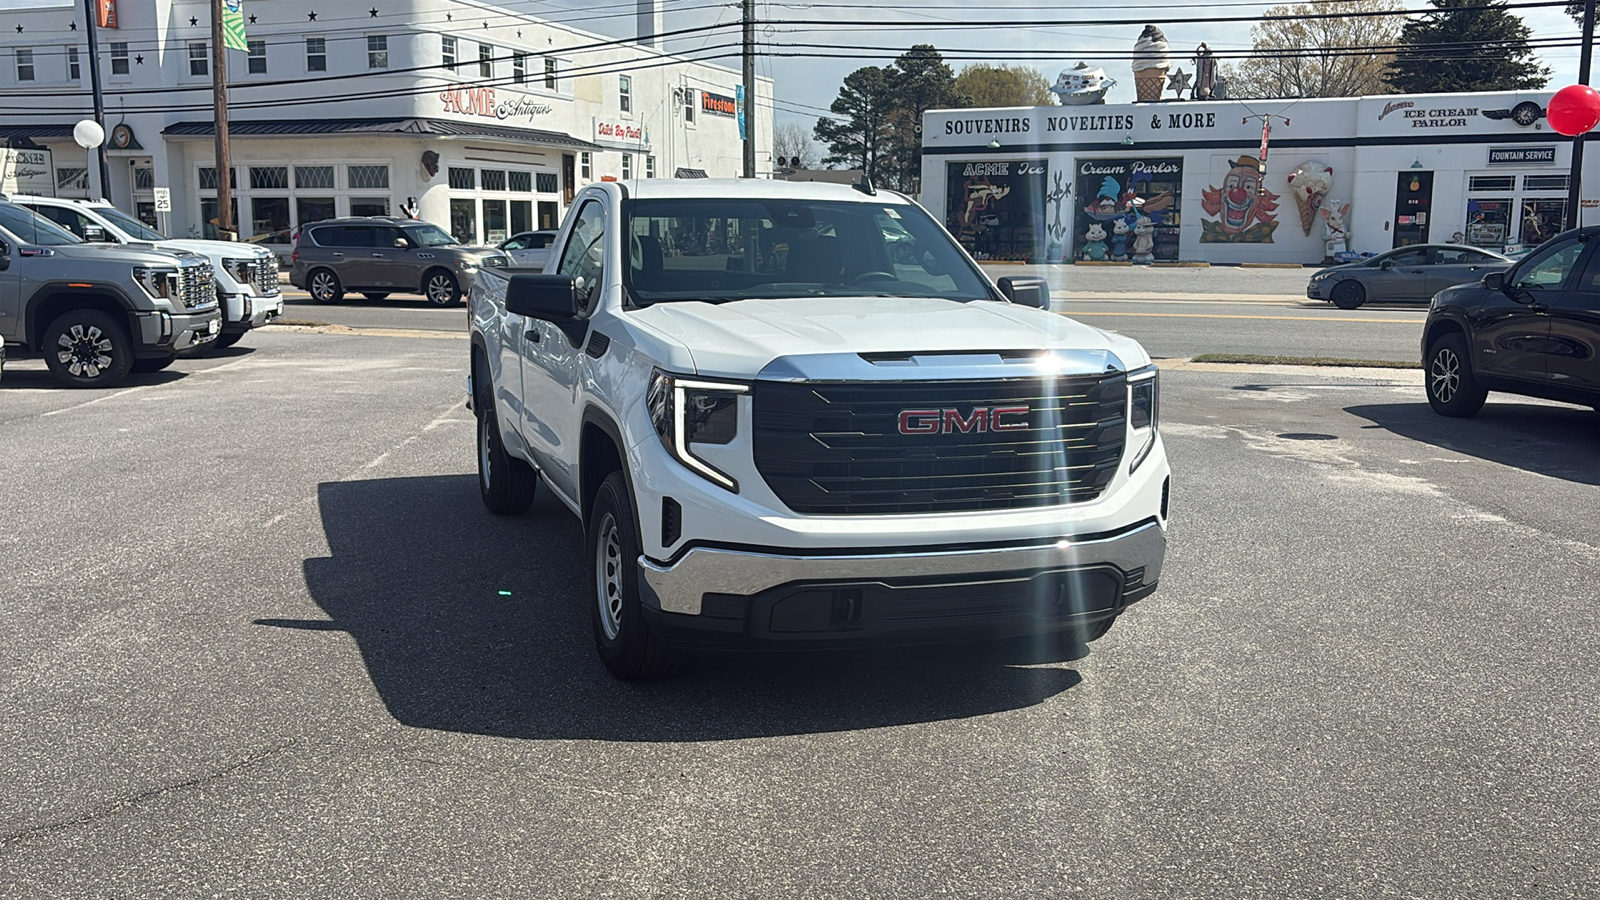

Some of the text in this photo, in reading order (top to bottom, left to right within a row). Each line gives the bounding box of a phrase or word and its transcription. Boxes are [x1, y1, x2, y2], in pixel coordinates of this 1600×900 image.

[440, 84, 552, 122] ACME Antiques
[702, 92, 735, 114] Firestone
[1404, 108, 1479, 118] ICE CREAM
[945, 113, 1216, 135] SOUVENIRS NOVELTIES & MORE
[1412, 118, 1467, 128] PARLOR
[598, 123, 614, 136] Dutch
[615, 124, 625, 140] Boy
[1491, 150, 1553, 161] FOUNTAIN SERVICE
[963, 162, 1045, 176] ACME Ice
[1081, 161, 1180, 174] Cream Parlor
[157, 200, 169, 208] 25
[898, 405, 1029, 434] GMC
